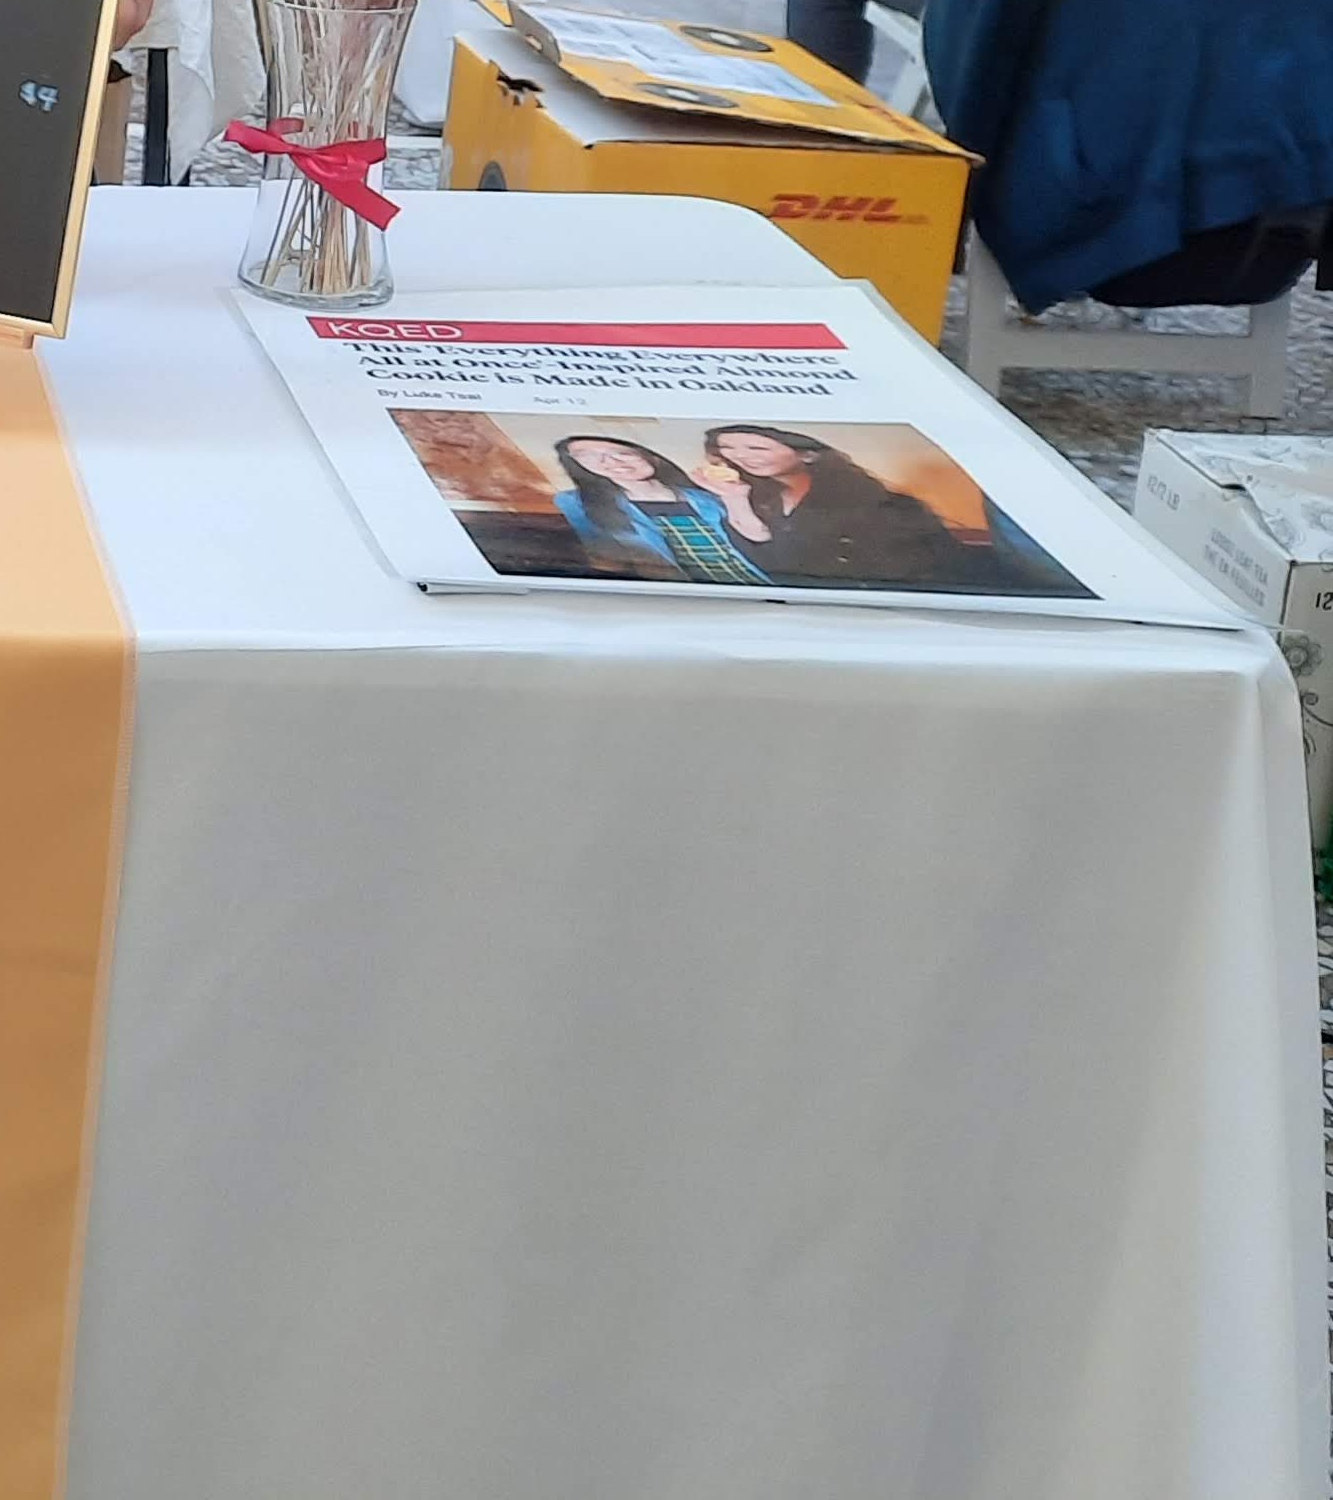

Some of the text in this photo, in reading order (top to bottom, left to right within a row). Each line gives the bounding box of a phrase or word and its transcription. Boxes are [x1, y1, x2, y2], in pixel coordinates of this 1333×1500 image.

[769, 194, 901, 222] DHL
[328, 321, 463, 340] KQED
[343, 342, 421, 353] This
[629, 349, 841, 366] Everywhere
[359, 356, 406, 366] All
[413, 357, 445, 367] at
[716, 365, 858, 381] Almond
[366, 369, 834, 396] Cookie is Made in Oakland
[377, 389, 397, 399] By
